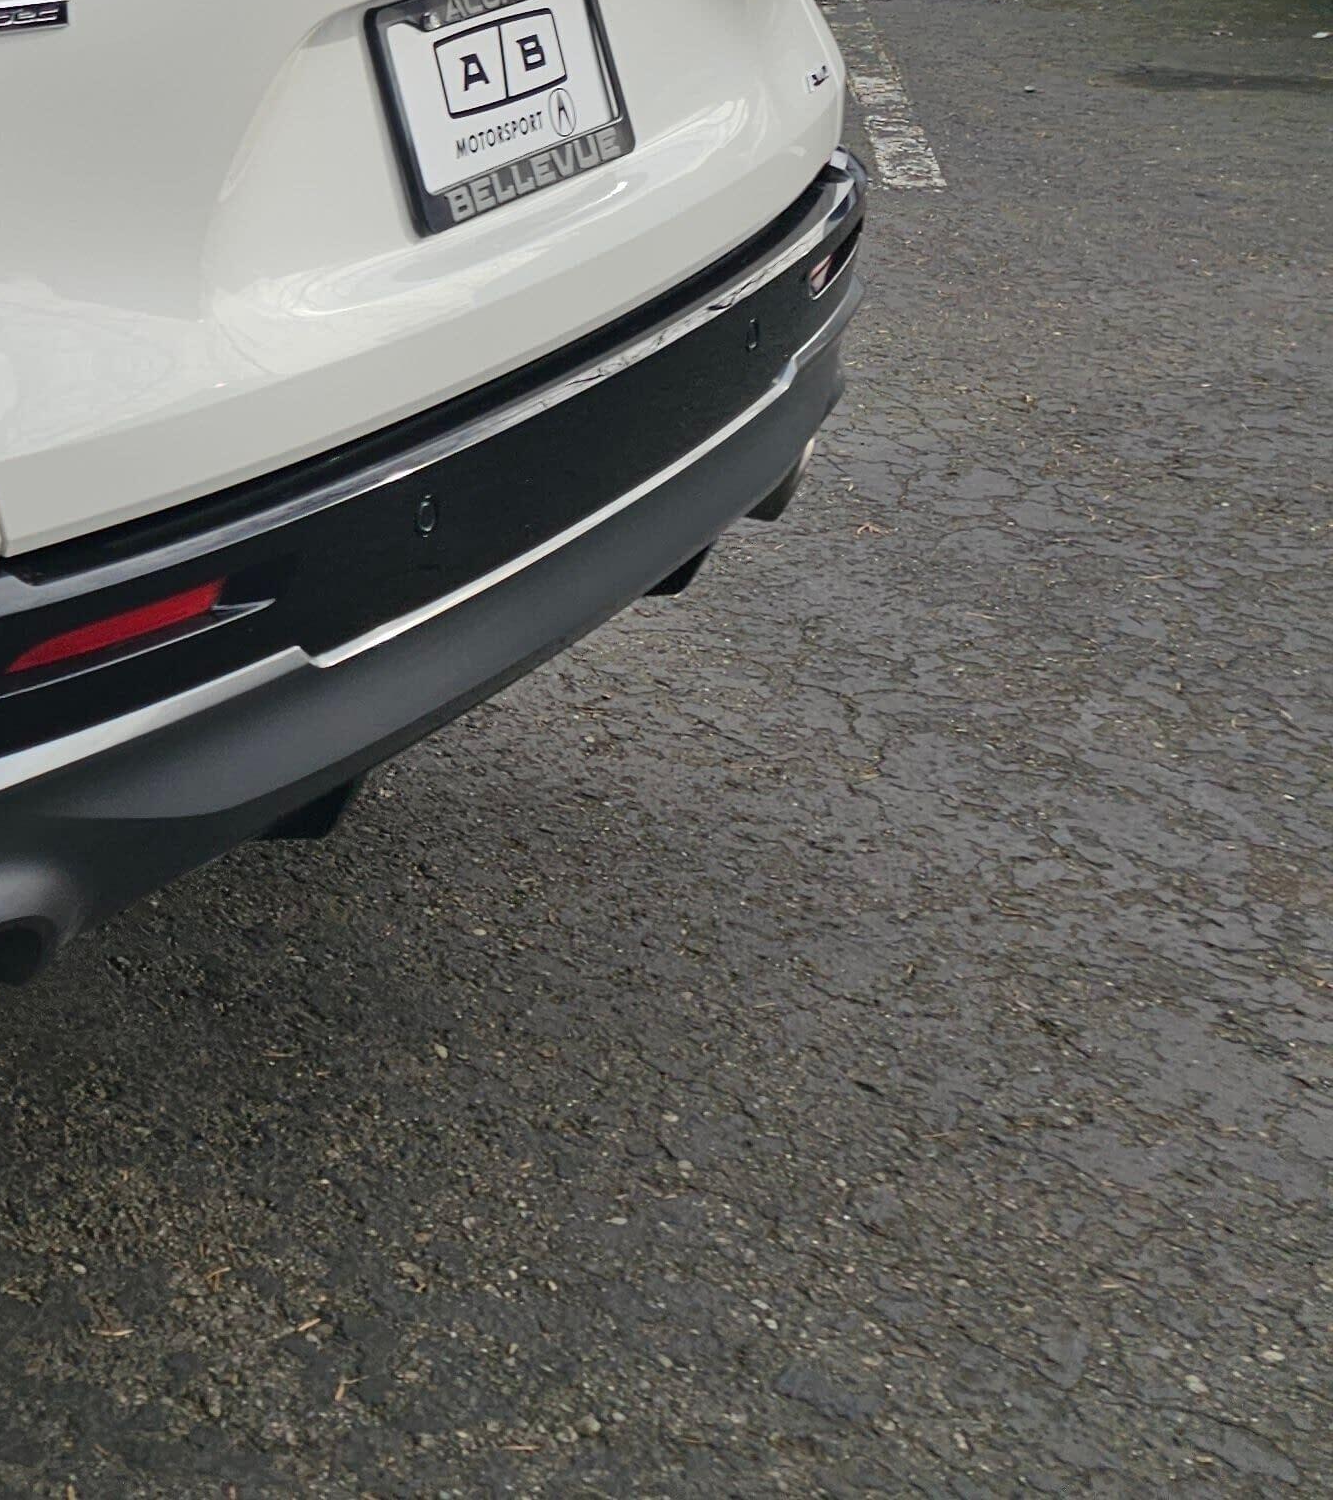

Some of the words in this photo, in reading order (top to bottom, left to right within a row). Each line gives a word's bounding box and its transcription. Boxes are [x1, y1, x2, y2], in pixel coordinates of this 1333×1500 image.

[459, 53, 490, 92] A
[515, 33, 547, 72] B
[455, 111, 544, 159] MOTORSPORT
[443, 129, 621, 224] BELLEVUE
